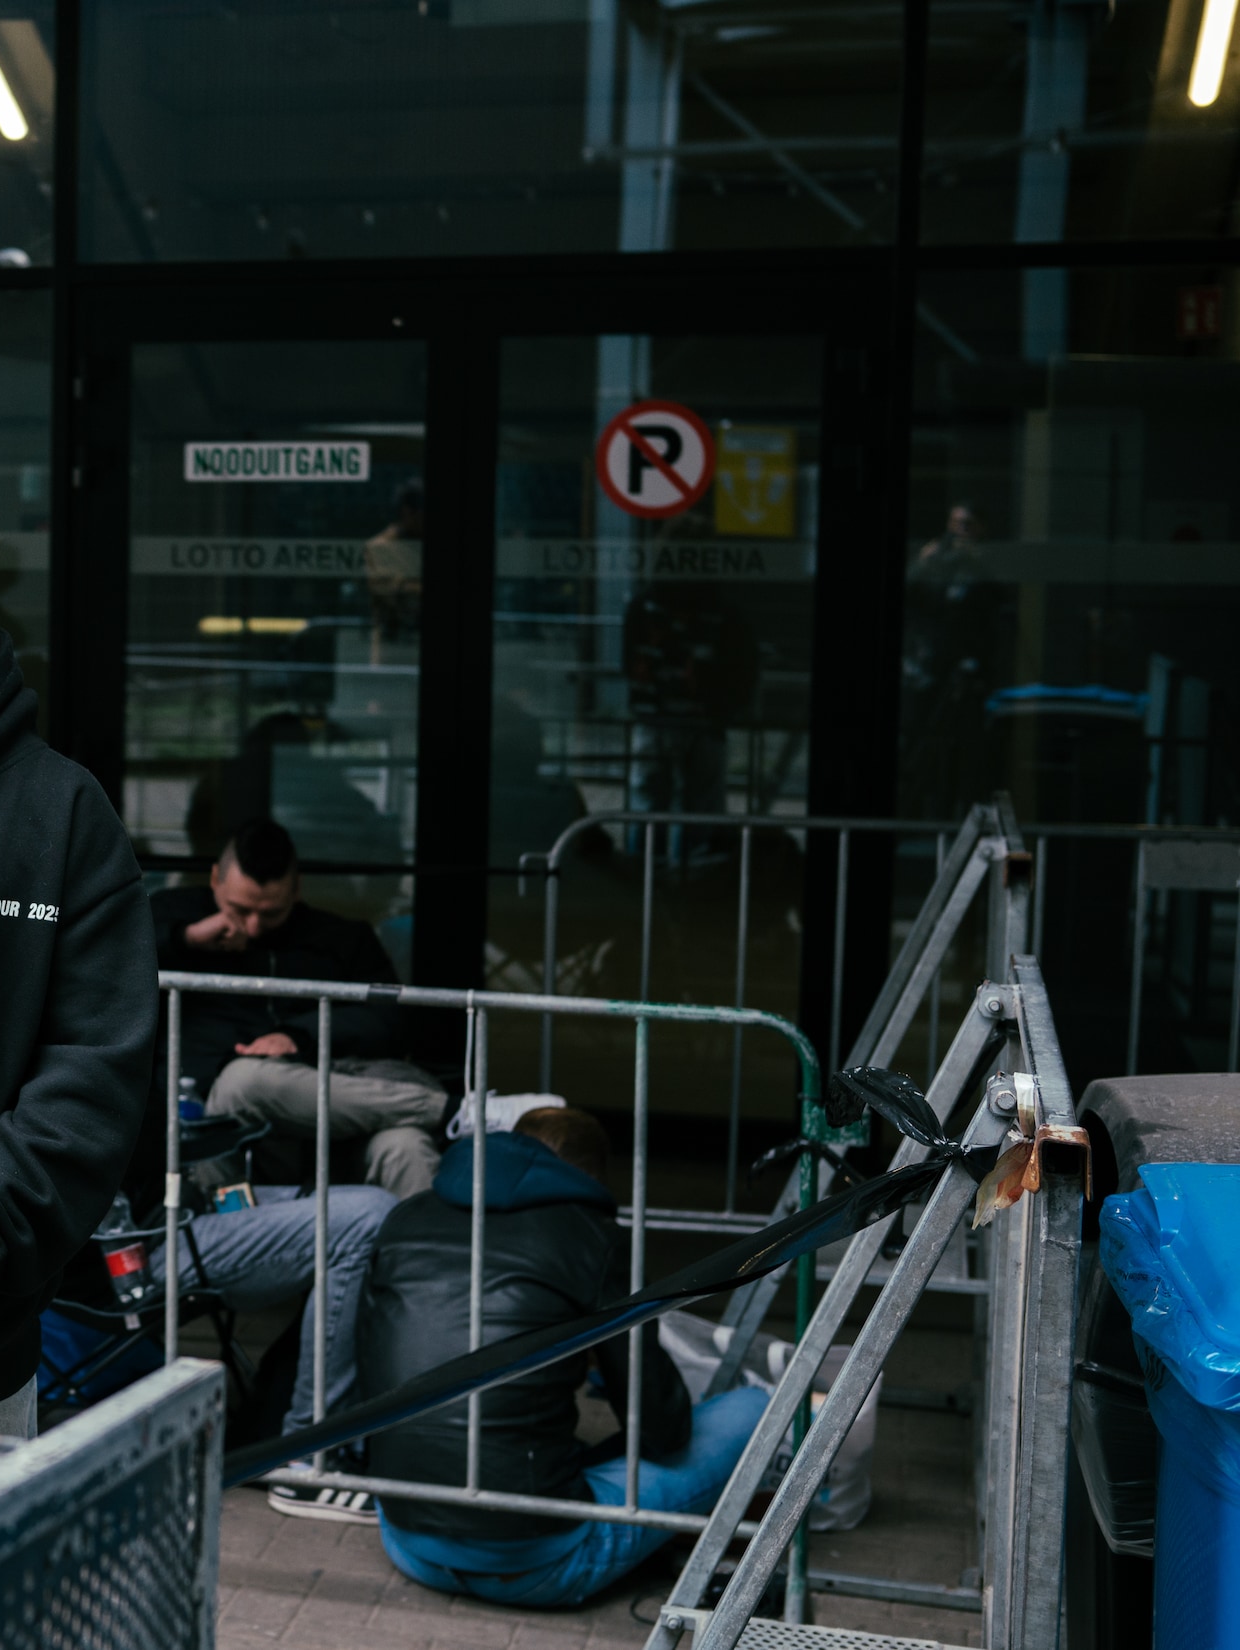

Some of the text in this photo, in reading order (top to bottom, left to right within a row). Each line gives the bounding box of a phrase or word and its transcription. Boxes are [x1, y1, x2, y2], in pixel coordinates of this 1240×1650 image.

[193, 446, 362, 476] NOODUITGANG
[170, 543, 266, 569] LOTTO
[654, 546, 766, 574] ARENA
